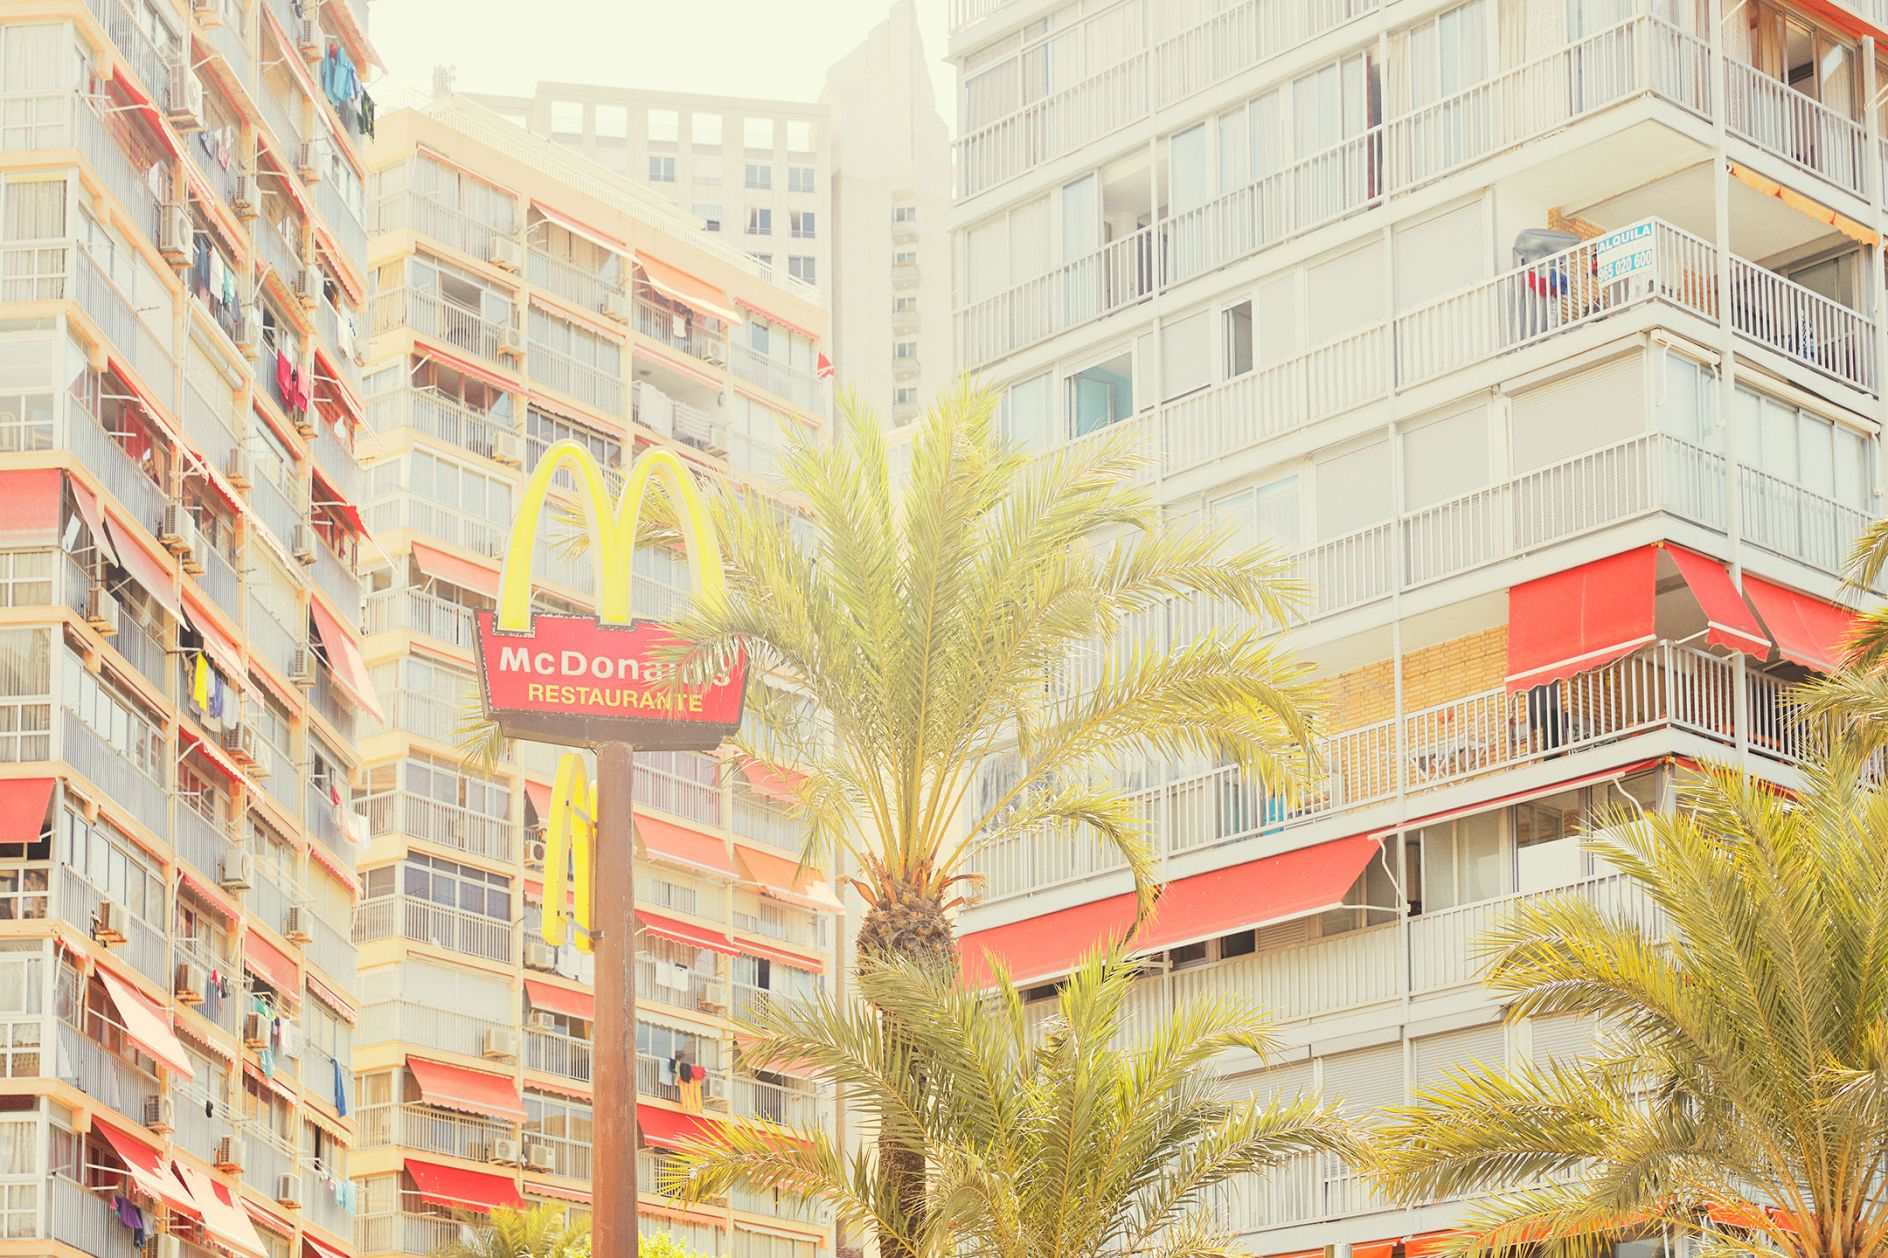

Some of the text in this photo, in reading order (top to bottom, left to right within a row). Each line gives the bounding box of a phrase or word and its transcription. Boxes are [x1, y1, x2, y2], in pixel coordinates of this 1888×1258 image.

[1598, 225, 1651, 254] ALQUILA
[1615, 256, 1632, 276] 020
[1634, 249, 1652, 269] 600
[528, 684, 704, 713] RESTAURANTE
